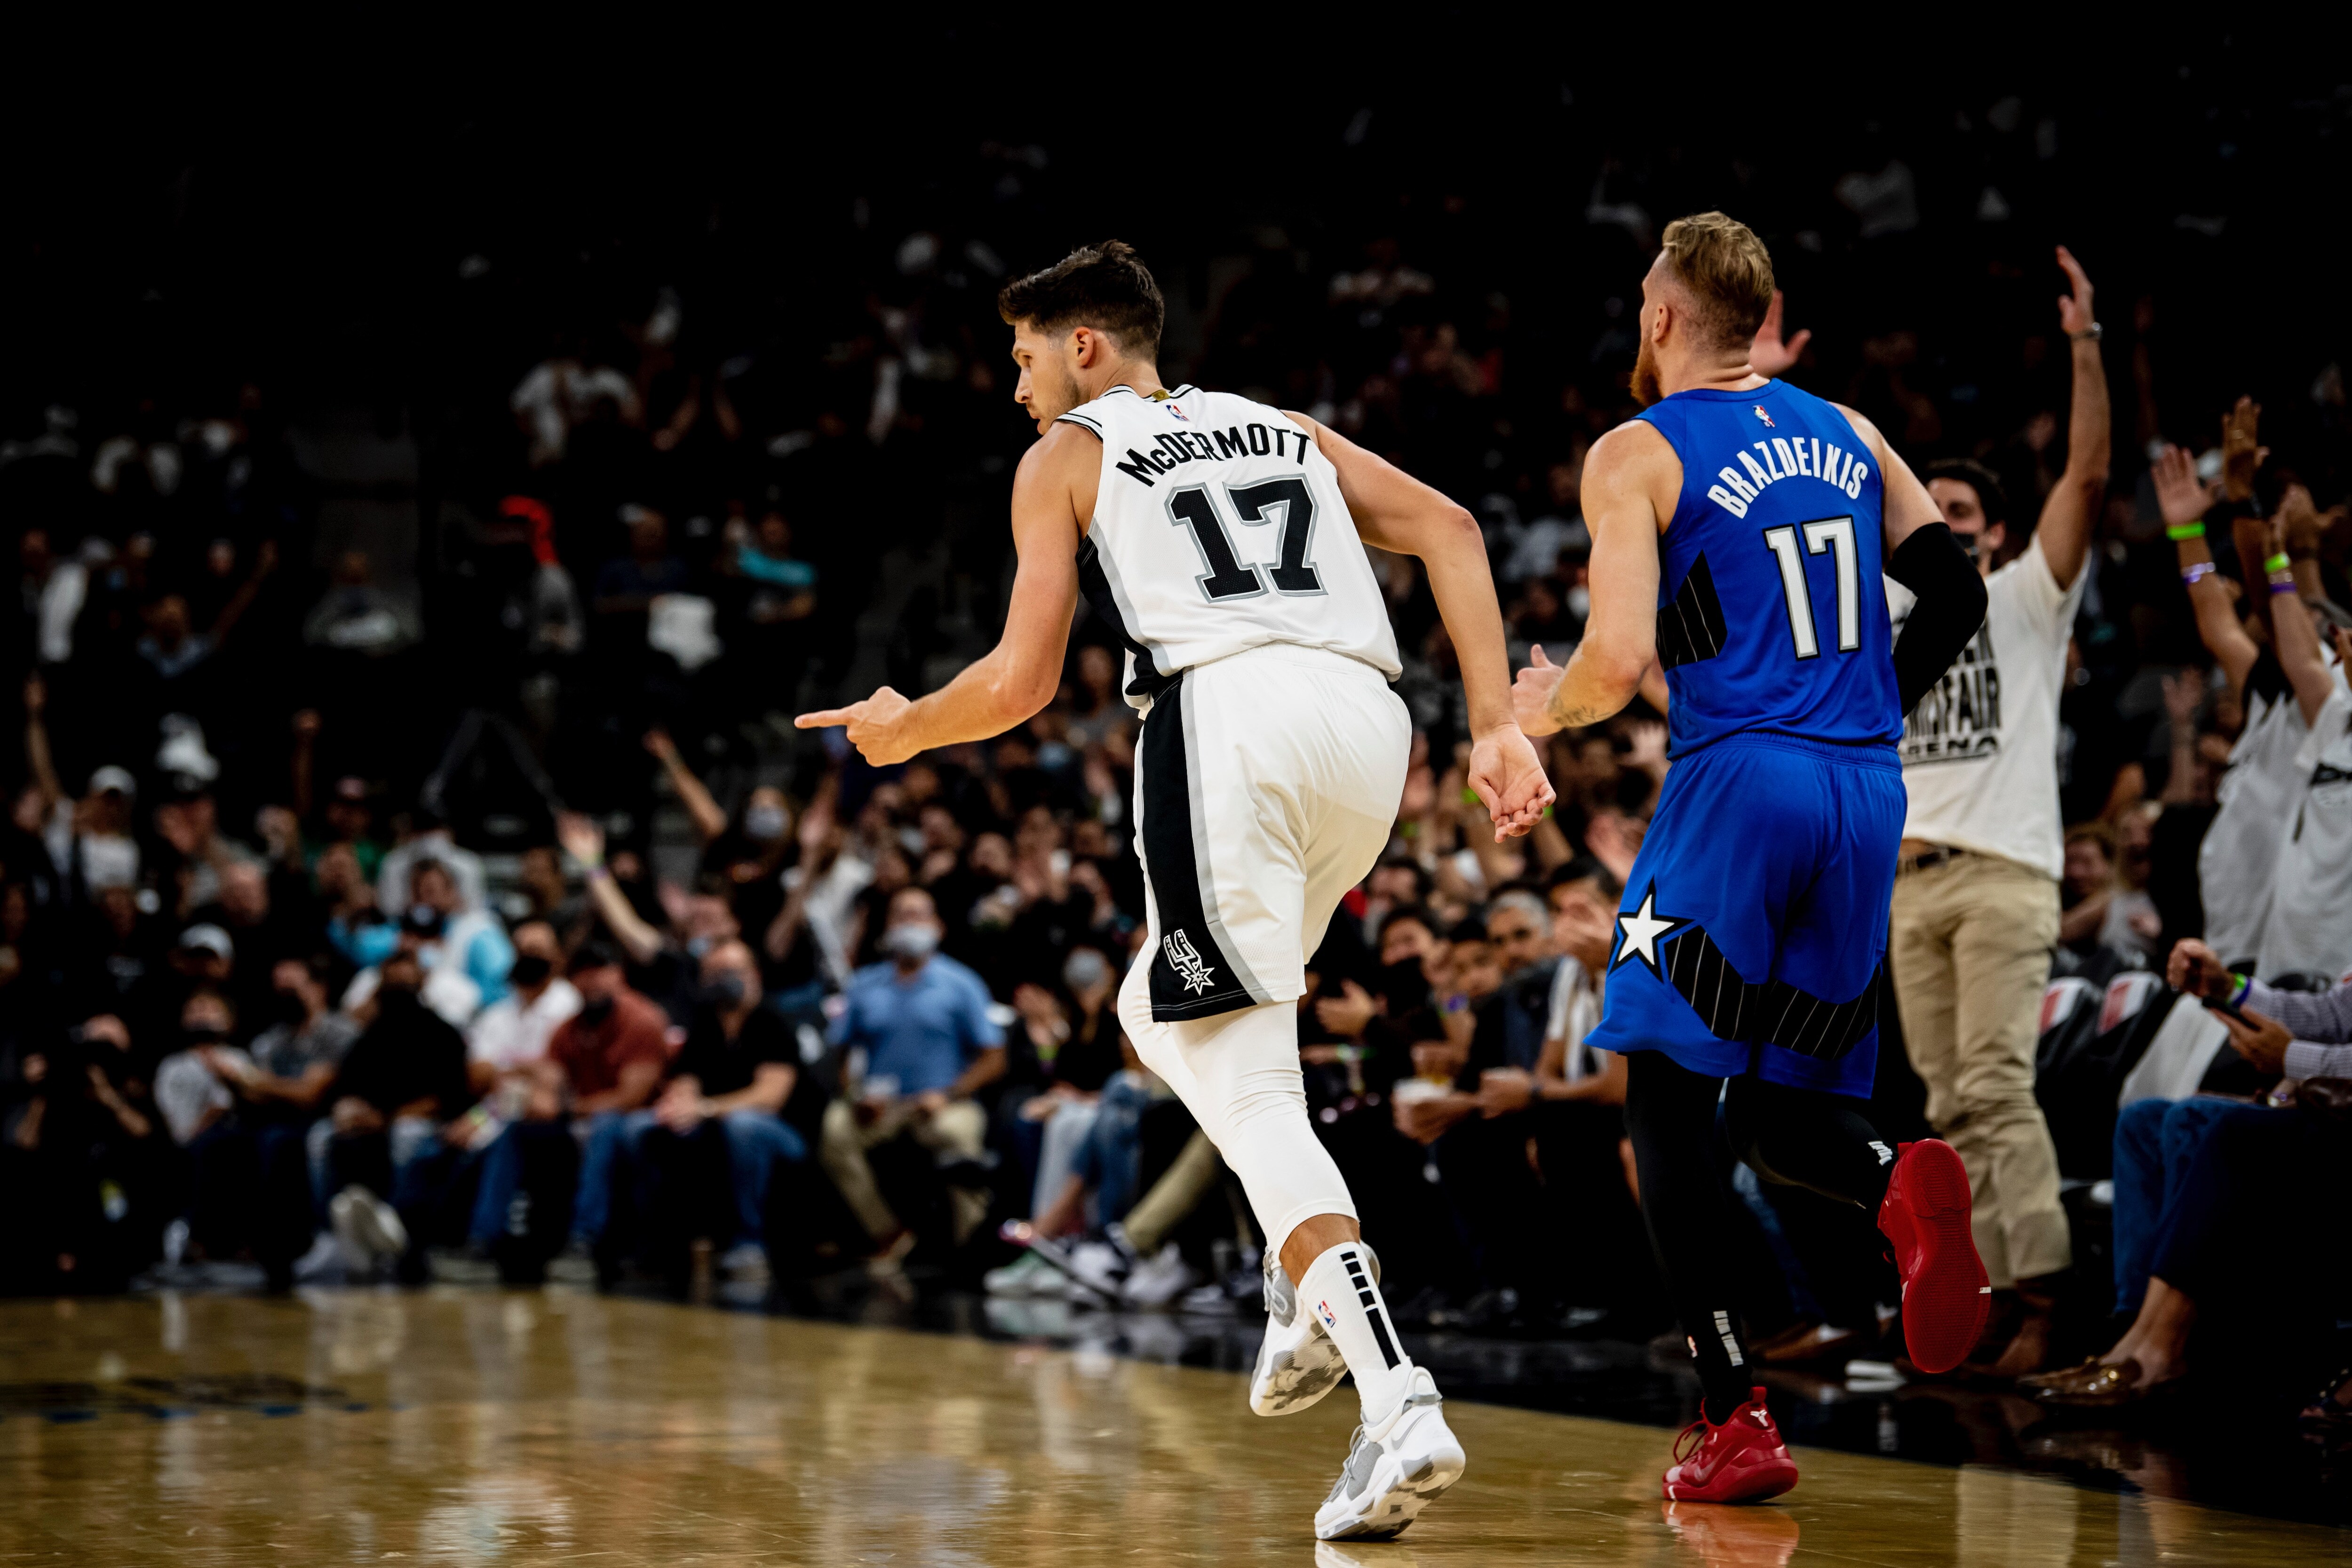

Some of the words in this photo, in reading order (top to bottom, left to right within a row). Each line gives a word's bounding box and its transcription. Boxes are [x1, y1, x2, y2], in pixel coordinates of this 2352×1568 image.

[1115, 423, 1311, 487] McDERMOTT
[1707, 437, 1868, 519] BRAZDEIKIS
[1164, 472, 1328, 604] 17
[1763, 514, 1861, 661] 17
